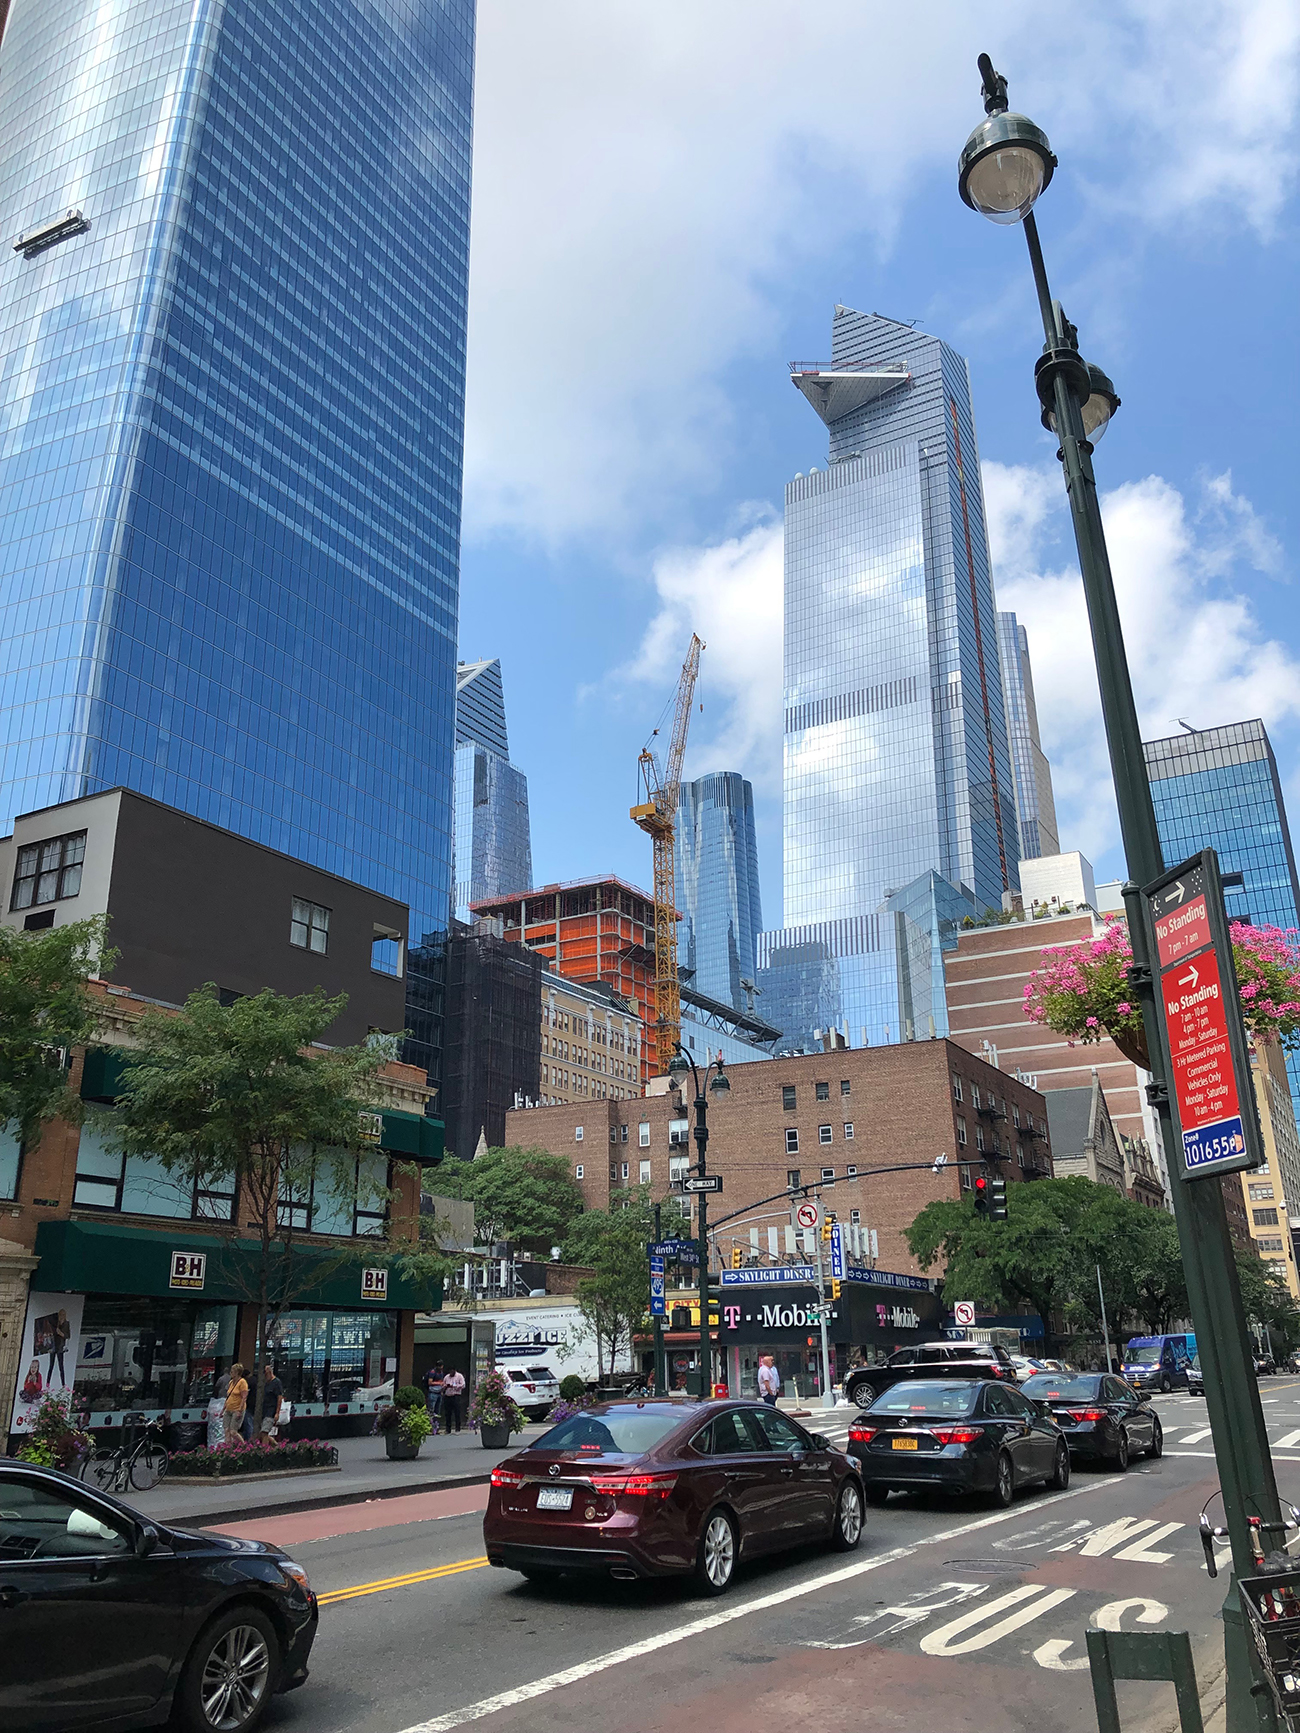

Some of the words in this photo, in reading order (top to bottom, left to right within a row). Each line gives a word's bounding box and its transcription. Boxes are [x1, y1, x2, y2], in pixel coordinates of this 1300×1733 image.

[1156, 925, 1168, 941] No
[1168, 903, 1206, 934] Standing
[1168, 944, 1172, 955] 7
[1173, 941, 1182, 956] pm
[1184, 934, 1189, 946] 7
[1189, 931, 1199, 944] am
[1167, 1001, 1180, 1016] No
[1180, 983, 1219, 1010] Standing
[1181, 1014, 1184, 1024] 7
[1184, 1012, 1192, 1022] am
[1194, 1007, 1200, 1017] 10
[1200, 1005, 1208, 1015] am
[1183, 1025, 1187, 1034] 4
[1187, 1023, 1195, 1035] pm
[1196, 1019, 1201, 1028] 7
[1201, 1017, 1209, 1029] pm
[1178, 1035, 1196, 1049] Monday
[1198, 1027, 1218, 1042] Saturday
[1176, 1059, 1181, 1068] 3
[1180, 1056, 1187, 1066] Hr
[1186, 1048, 1206, 1064] Metered
[1206, 1042, 1226, 1056] Parking
[1187, 1058, 1218, 1078] Commercial
[1187, 1077, 1208, 1091] Vehicles
[1208, 1071, 1222, 1083] Only
[1185, 1092, 1204, 1106] Monday
[1206, 1084, 1229, 1099] Saturday
[1194, 1106, 1200, 1117] 10
[1200, 1105, 1208, 1115] am
[1210, 1102, 1214, 1112] 4
[1214, 1101, 1223, 1113] pm
[1186, 1136, 1230, 1164] 101655
[832, 1229, 841, 1275] DINER
[739, 1269, 781, 1282] SKYLIGHT
[784, 1268, 811, 1281] DINER
[870, 1273, 894, 1286] SKYLIGHT
[895, 1276, 910, 1287] DINER
[540, 1330, 567, 1343] ICE
